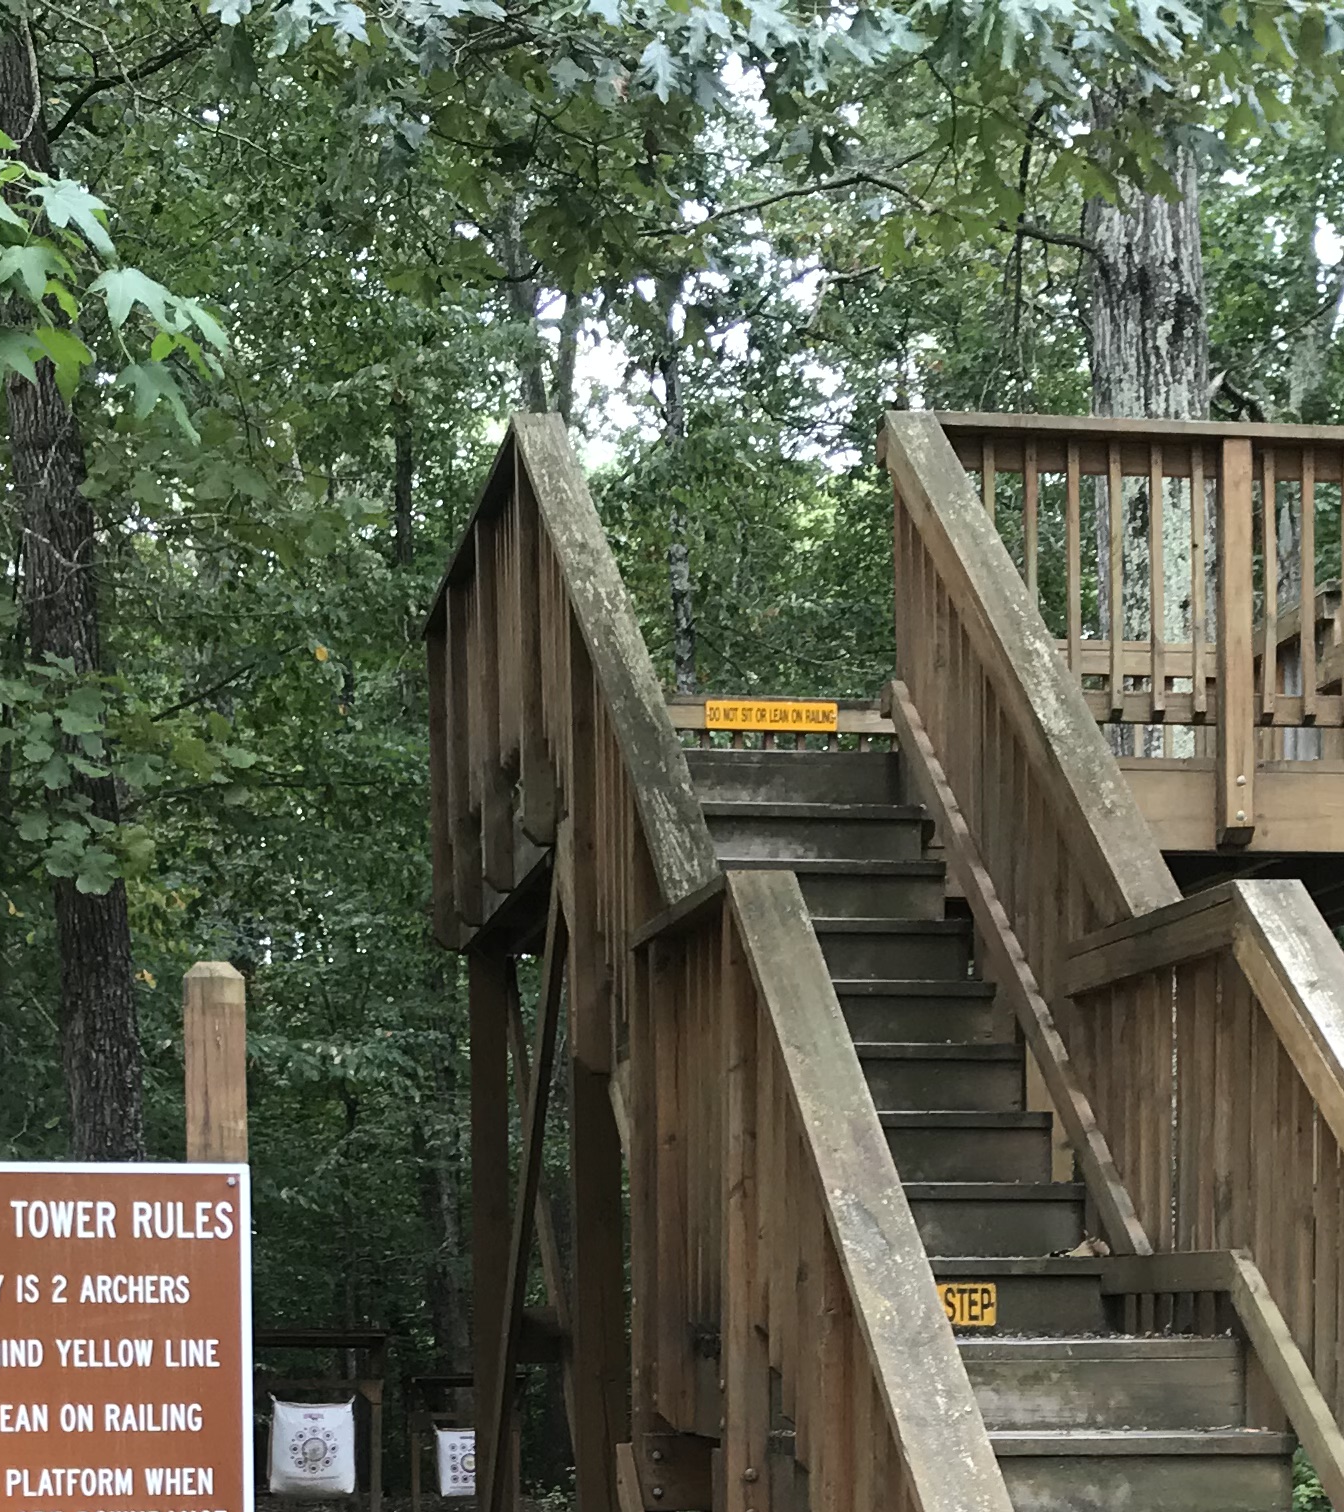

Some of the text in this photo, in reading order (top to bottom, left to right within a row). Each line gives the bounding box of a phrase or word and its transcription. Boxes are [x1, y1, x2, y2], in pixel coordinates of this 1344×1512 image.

[709, 707, 835, 724] DO NOT SIT OR LEAN ON RAILING
[10, 1200, 117, 1239] TOWER
[133, 1201, 234, 1240] RULES
[17, 1274, 40, 1303] IS
[52, 1275, 67, 1303] 2
[80, 1275, 190, 1303] ARCHERS
[945, 1287, 992, 1322] STEP
[56, 1339, 153, 1368] YELLOW
[165, 1339, 220, 1368] LINE
[60, 1404, 93, 1432] ON
[105, 1403, 202, 1432] RAILING
[6, 1468, 133, 1497] PLATFORM
[145, 1468, 213, 1496] WHEN
